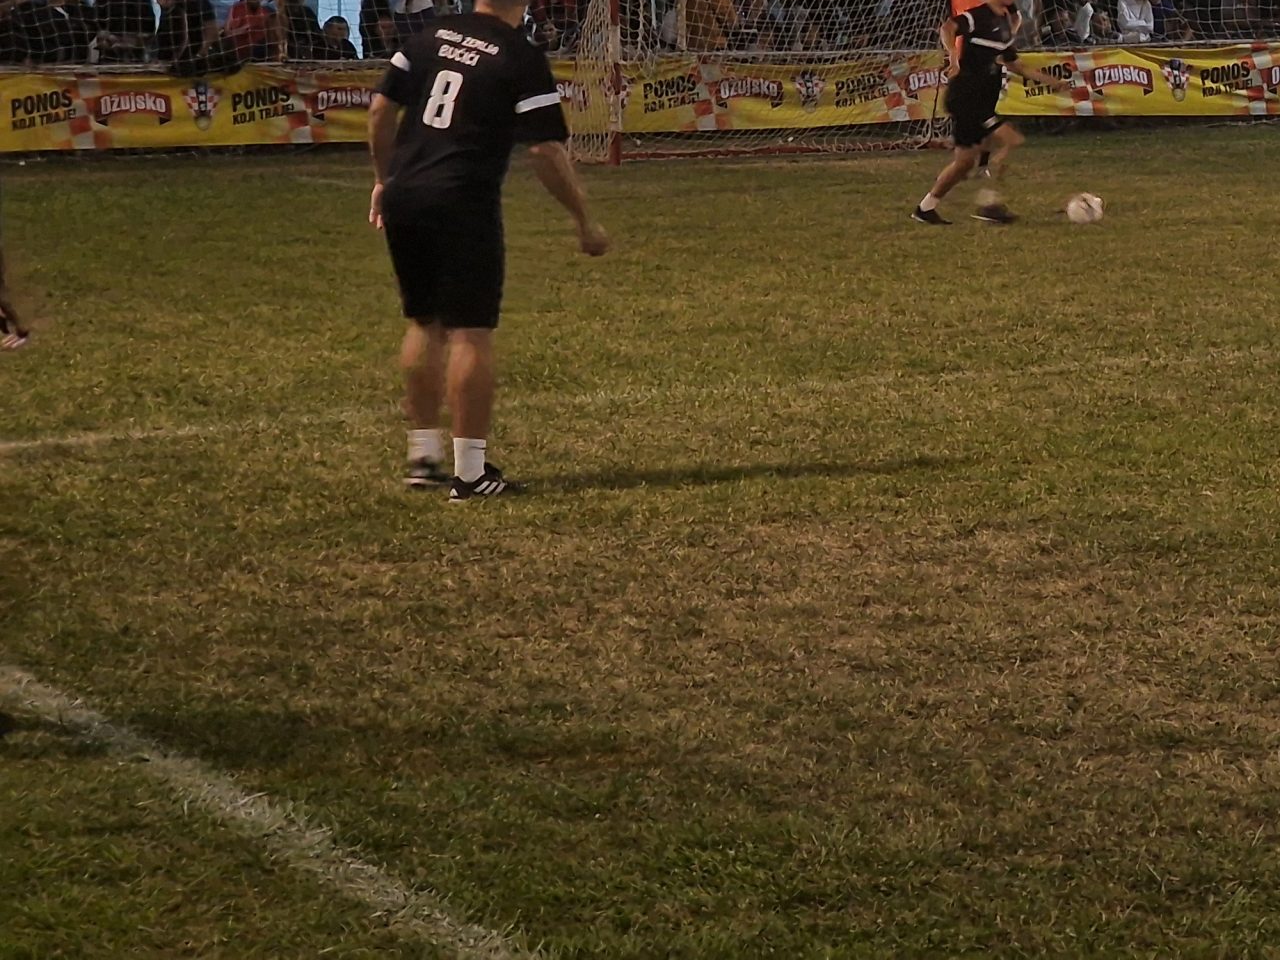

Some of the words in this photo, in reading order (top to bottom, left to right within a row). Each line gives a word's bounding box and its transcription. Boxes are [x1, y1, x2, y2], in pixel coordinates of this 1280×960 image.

[909, 69, 949, 91] Ožujs
[1094, 65, 1148, 87] Ožujsko
[1200, 61, 1250, 85] PONOS
[231, 85, 290, 112] PONOS
[643, 74, 697, 100] PONOS
[1202, 85, 1221, 98] KOJI
[1223, 79, 1253, 93] TRAJE!
[11, 89, 74, 119] PONOS
[101, 92, 166, 116] Ožujsko
[422, 70, 463, 129] 8
[12, 116, 36, 131] KOJI
[40, 108, 77, 127] TRAJE!
[232, 111, 256, 125] KOJI
[259, 104, 294, 121] TRAJE!
